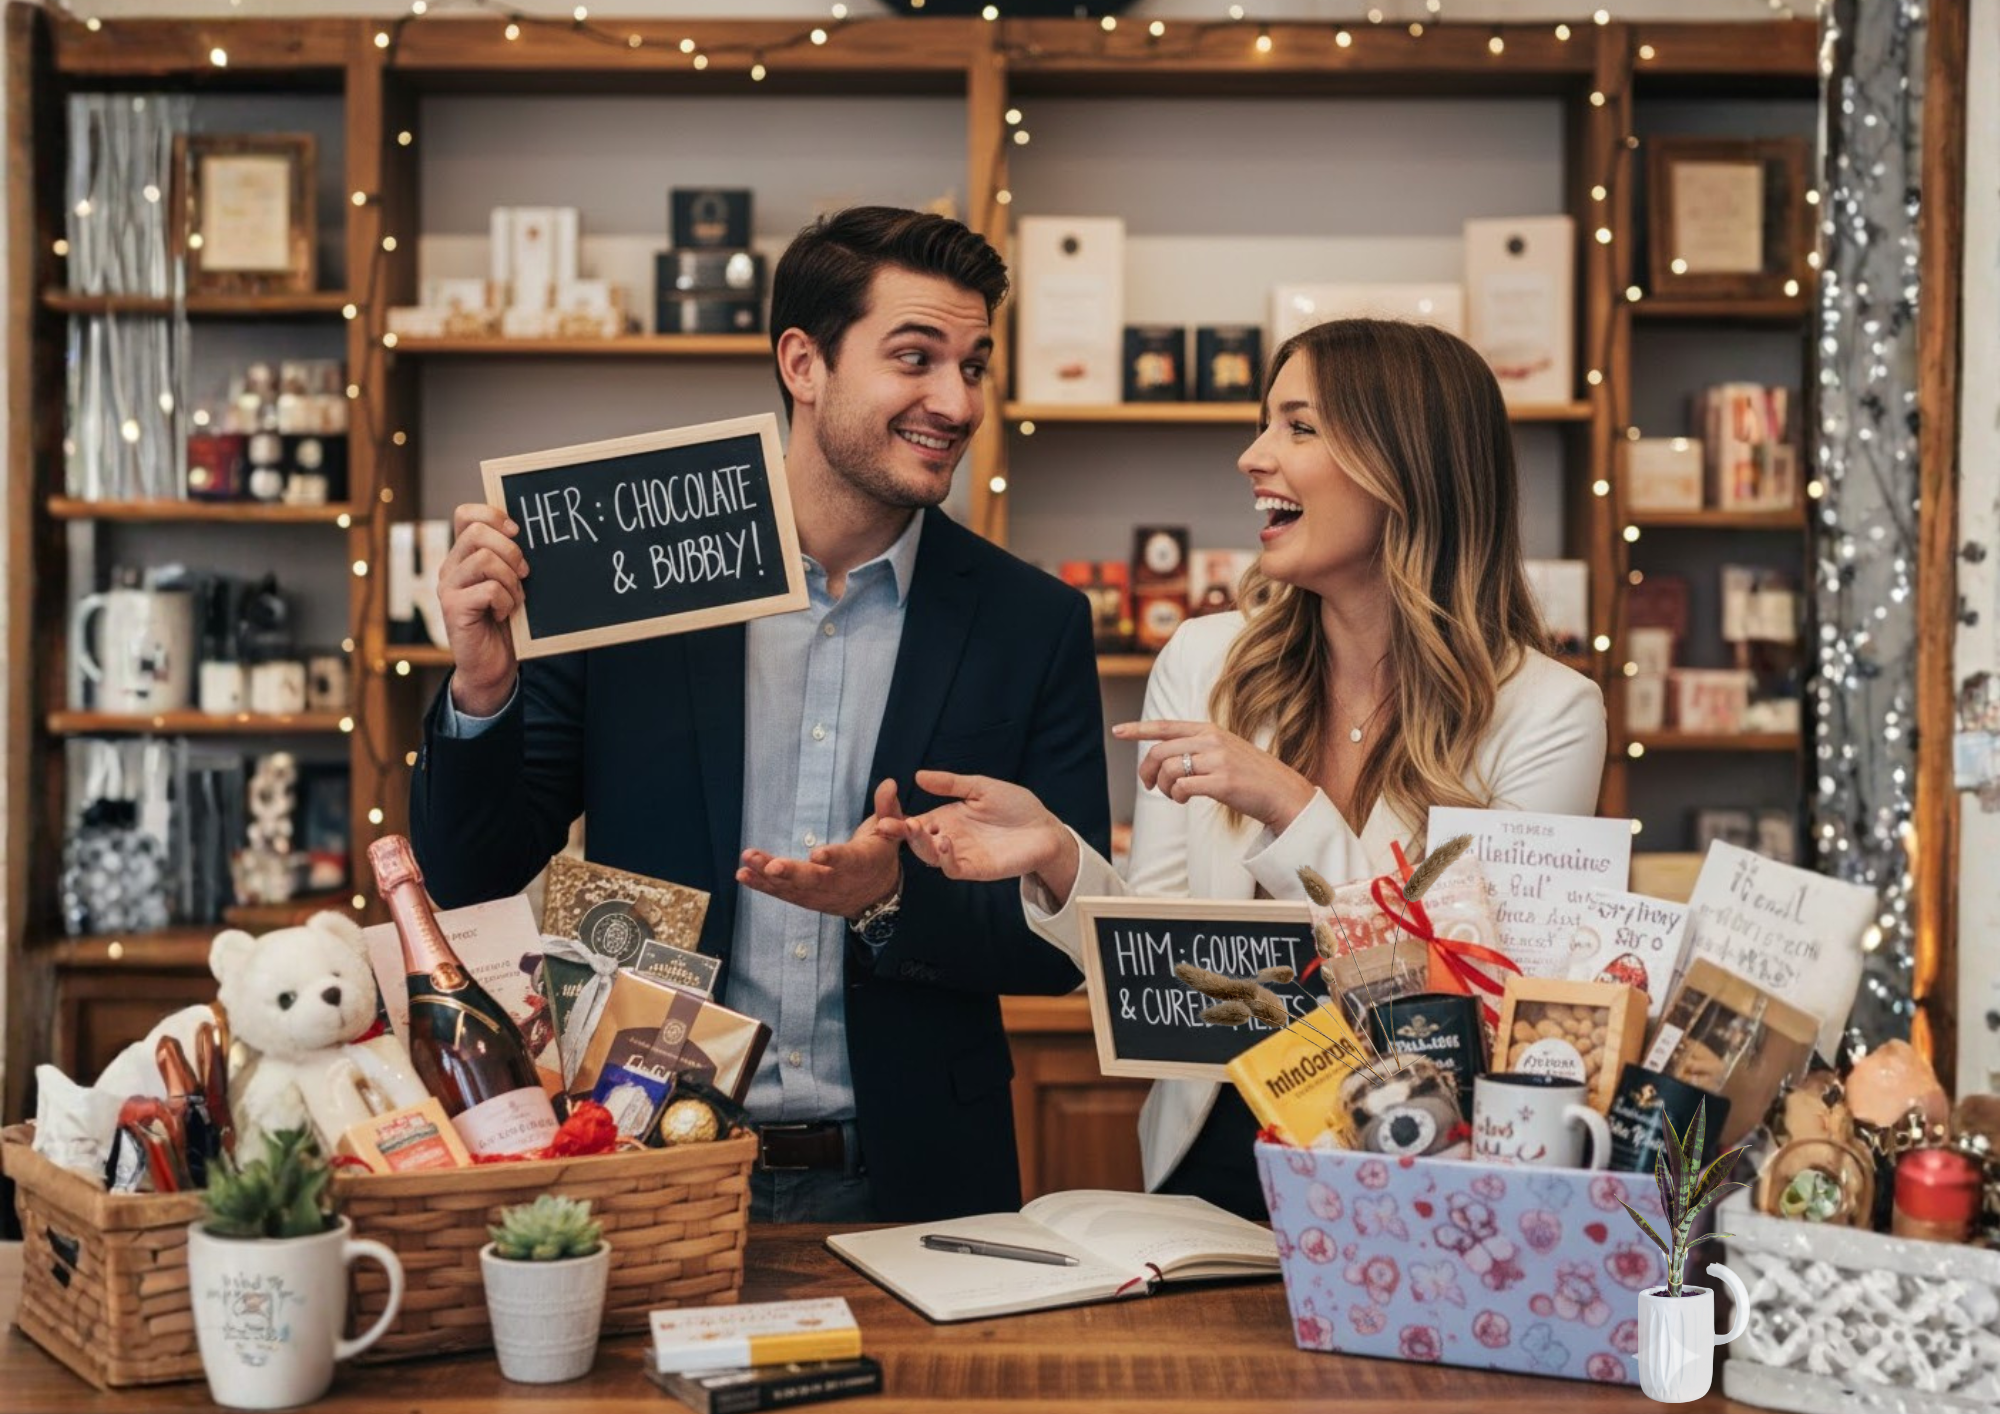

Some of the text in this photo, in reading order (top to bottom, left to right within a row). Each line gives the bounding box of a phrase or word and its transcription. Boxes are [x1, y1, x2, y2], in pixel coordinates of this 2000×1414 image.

[614, 464, 757, 532] CHOCOLATE
[612, 520, 765, 594] & BUBBLY!
[1192, 934, 1301, 977] GOURMET
[1119, 988, 1138, 1020] &
